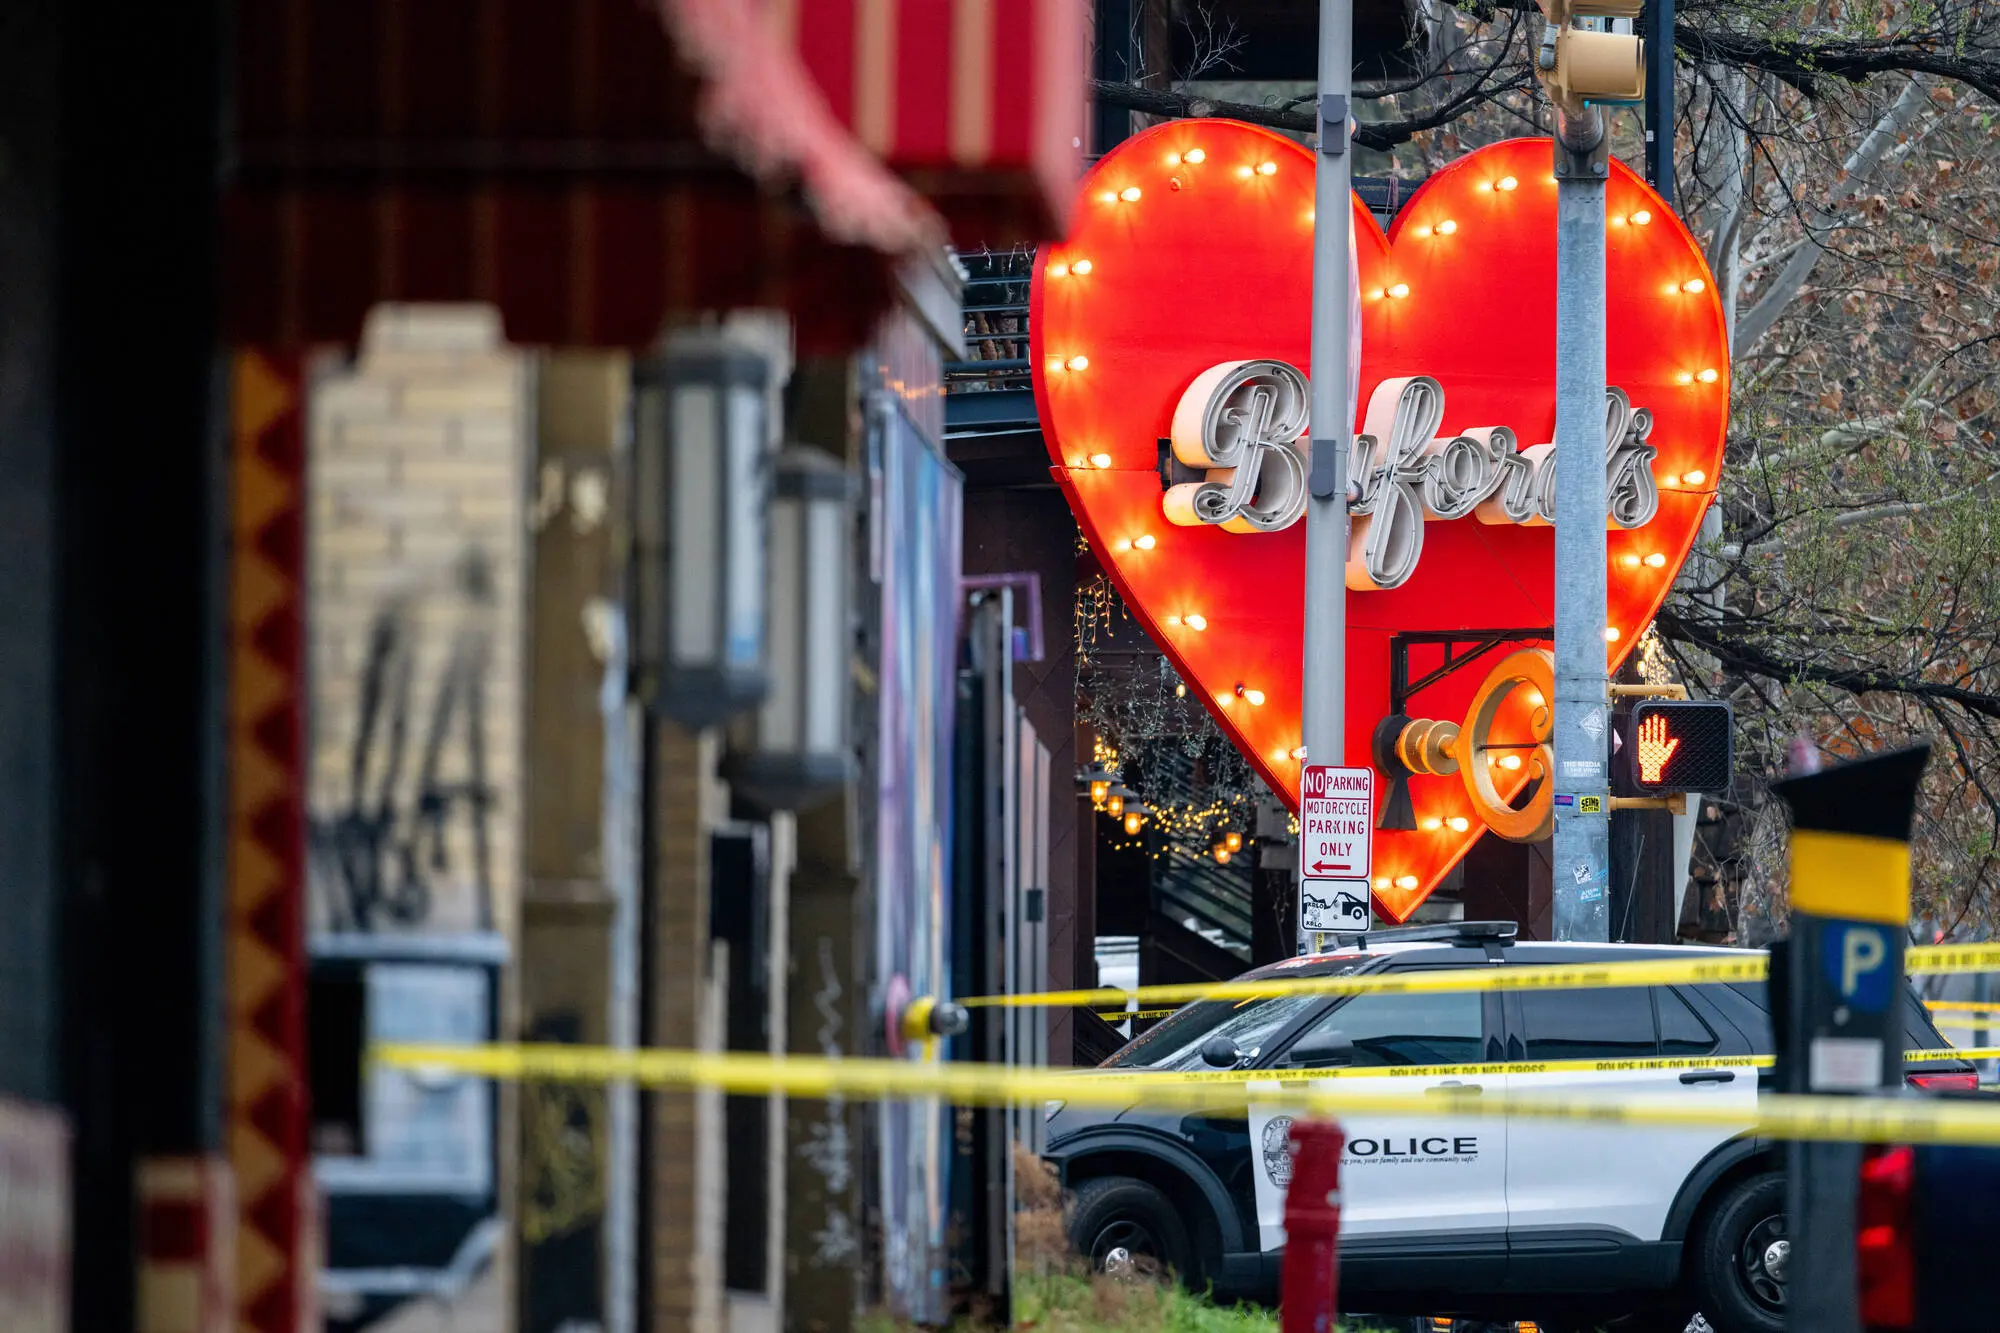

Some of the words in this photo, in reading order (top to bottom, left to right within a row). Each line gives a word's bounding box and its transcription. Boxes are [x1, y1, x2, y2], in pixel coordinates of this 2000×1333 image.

[1305, 772, 1324, 793] NO
[1327, 776, 1369, 791] PARKING
[1307, 801, 1367, 815] MOTORCYCLE
[1309, 820, 1365, 834] PARKING
[1320, 842, 1352, 856] ONLY
[1842, 928, 1885, 997] P
[1482, 1065, 1504, 1073] NOT
[1596, 1062, 1635, 1071] POLICE
[1669, 1060, 1684, 1069] DO
[1688, 1059, 1711, 1068] NOT
[1714, 1057, 1752, 1066] CROSS
[1347, 1137, 1479, 1156] OLICE
